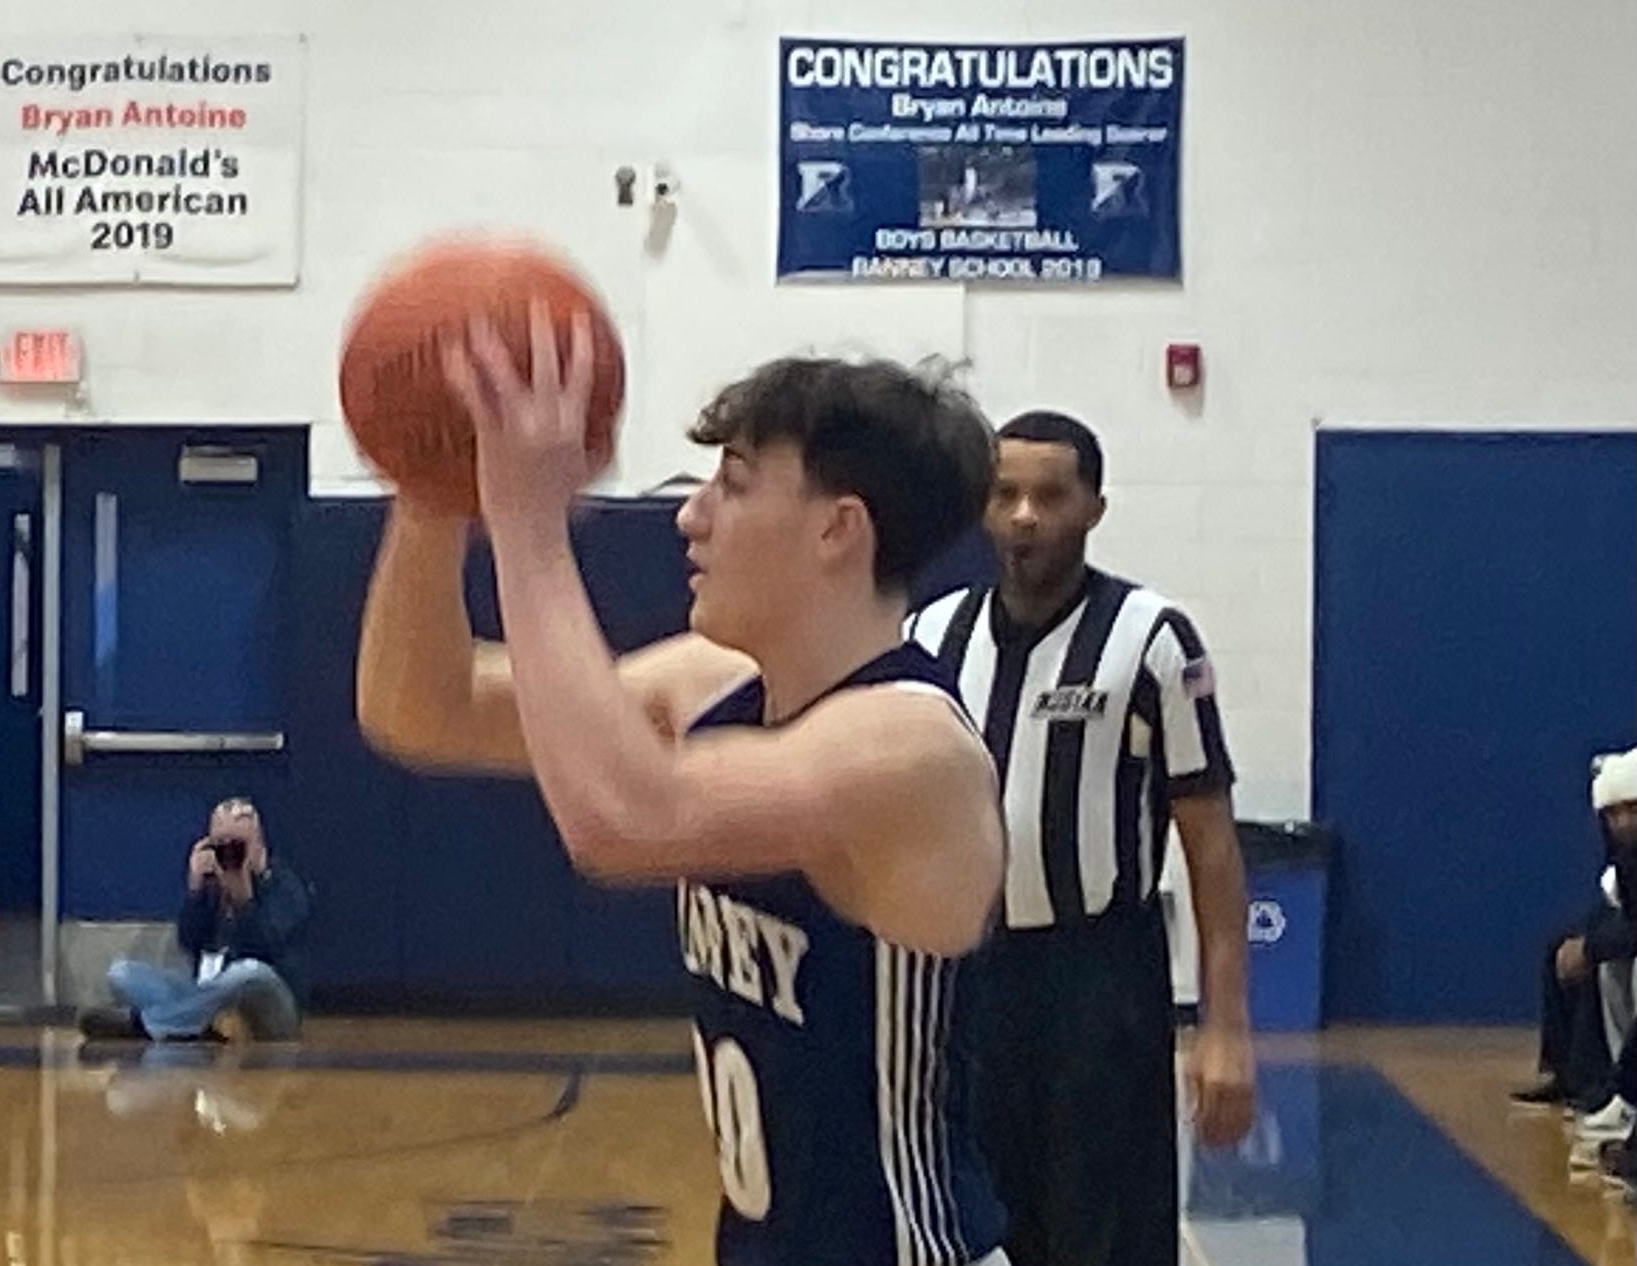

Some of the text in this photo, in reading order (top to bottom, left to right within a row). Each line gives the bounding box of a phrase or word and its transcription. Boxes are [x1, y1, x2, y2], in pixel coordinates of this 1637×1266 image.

[1, 55, 271, 90] Congratulations
[788, 48, 1174, 89] CONGRATULATIONS
[22, 101, 247, 135] Bryan Antoine
[892, 94, 966, 121] Bryan
[29, 150, 239, 179] McDonald's
[18, 187, 248, 215] All American
[91, 223, 174, 250] 2019
[678, 877, 810, 1026] NEY
